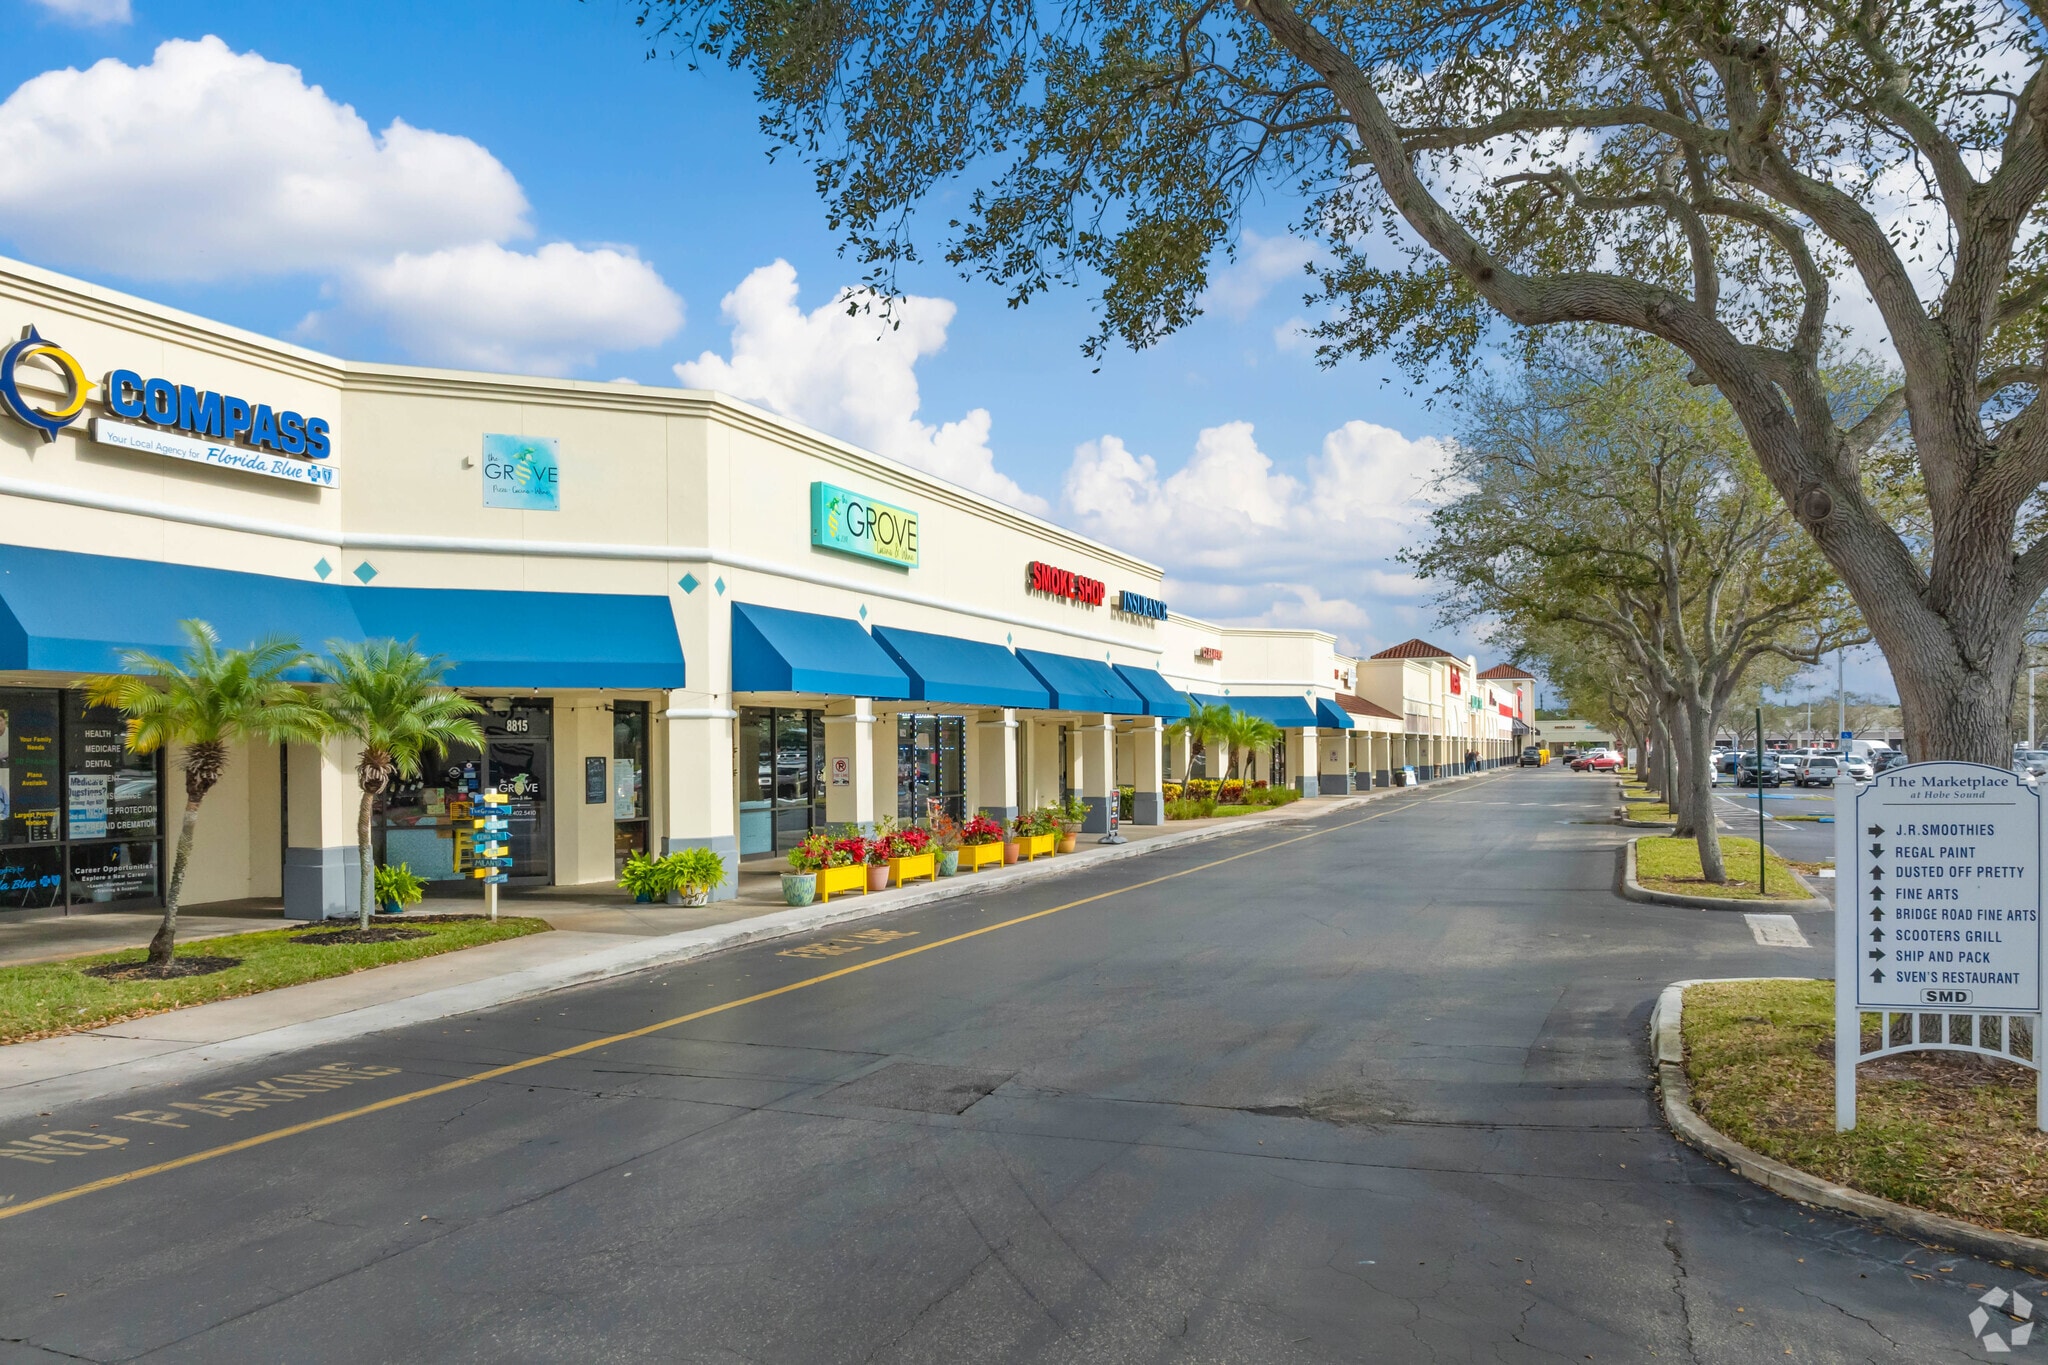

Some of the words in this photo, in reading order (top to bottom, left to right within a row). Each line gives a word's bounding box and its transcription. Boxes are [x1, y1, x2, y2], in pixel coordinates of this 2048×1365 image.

[105, 368, 331, 459] COMPASS
[107, 431, 127, 444] Your
[130, 437, 153, 449] Local
[156, 442, 187, 458] Agency
[189, 448, 201, 459] for
[206, 447, 267, 472] Florida
[271, 460, 303, 479] Blue
[846, 501, 917, 553] GROVE
[1032, 560, 1075, 599] SMOKE
[1076, 574, 1106, 607] SHOP
[1120, 589, 1169, 621] INSURANCE
[506, 718, 529, 733] 8815
[85, 729, 112, 738] HEALTH
[85, 744, 121, 753] MEDICARE
[85, 759, 113, 768] DENTAL
[1888, 776, 1916, 787] The
[1922, 775, 2009, 790] Marketplace
[1910, 791, 1920, 799] at
[1924, 790, 1951, 799] Hobe
[1954, 790, 1986, 799] Sound
[115, 805, 157, 815] PROTECTION
[117, 820, 157, 830] CREMATION
[1895, 847, 1935, 858] REGAL
[1940, 847, 1976, 858] PAINT
[74, 867, 101, 875] Career
[102, 863, 154, 873] Opportunities
[1896, 866, 1944, 878] DUSTED
[1949, 866, 1972, 878] OFF
[1977, 866, 2025, 878] PRETTY
[11, 877, 38, 891] Blue
[1896, 888, 1922, 900] FINE
[1927, 888, 1959, 900] ARTS
[1896, 908, 1937, 920] BRIDGE
[1942, 909, 1973, 921] ROAD
[1978, 909, 2002, 921] FINE
[2006, 909, 2037, 922] ARTS
[1896, 930, 1961, 942] SCOOTERS
[1965, 930, 2003, 943] GRILL
[1896, 950, 1925, 962] SHIP
[1928, 951, 1953, 963] AND
[1958, 951, 1990, 964] PACK
[1896, 971, 1938, 983] SVEN'S
[1942, 972, 2020, 985] RESTAURANT
[1926, 990, 1968, 1003] SMD
[0, 1129, 130, 1165] NO
[112, 1061, 402, 1129] PARKING
